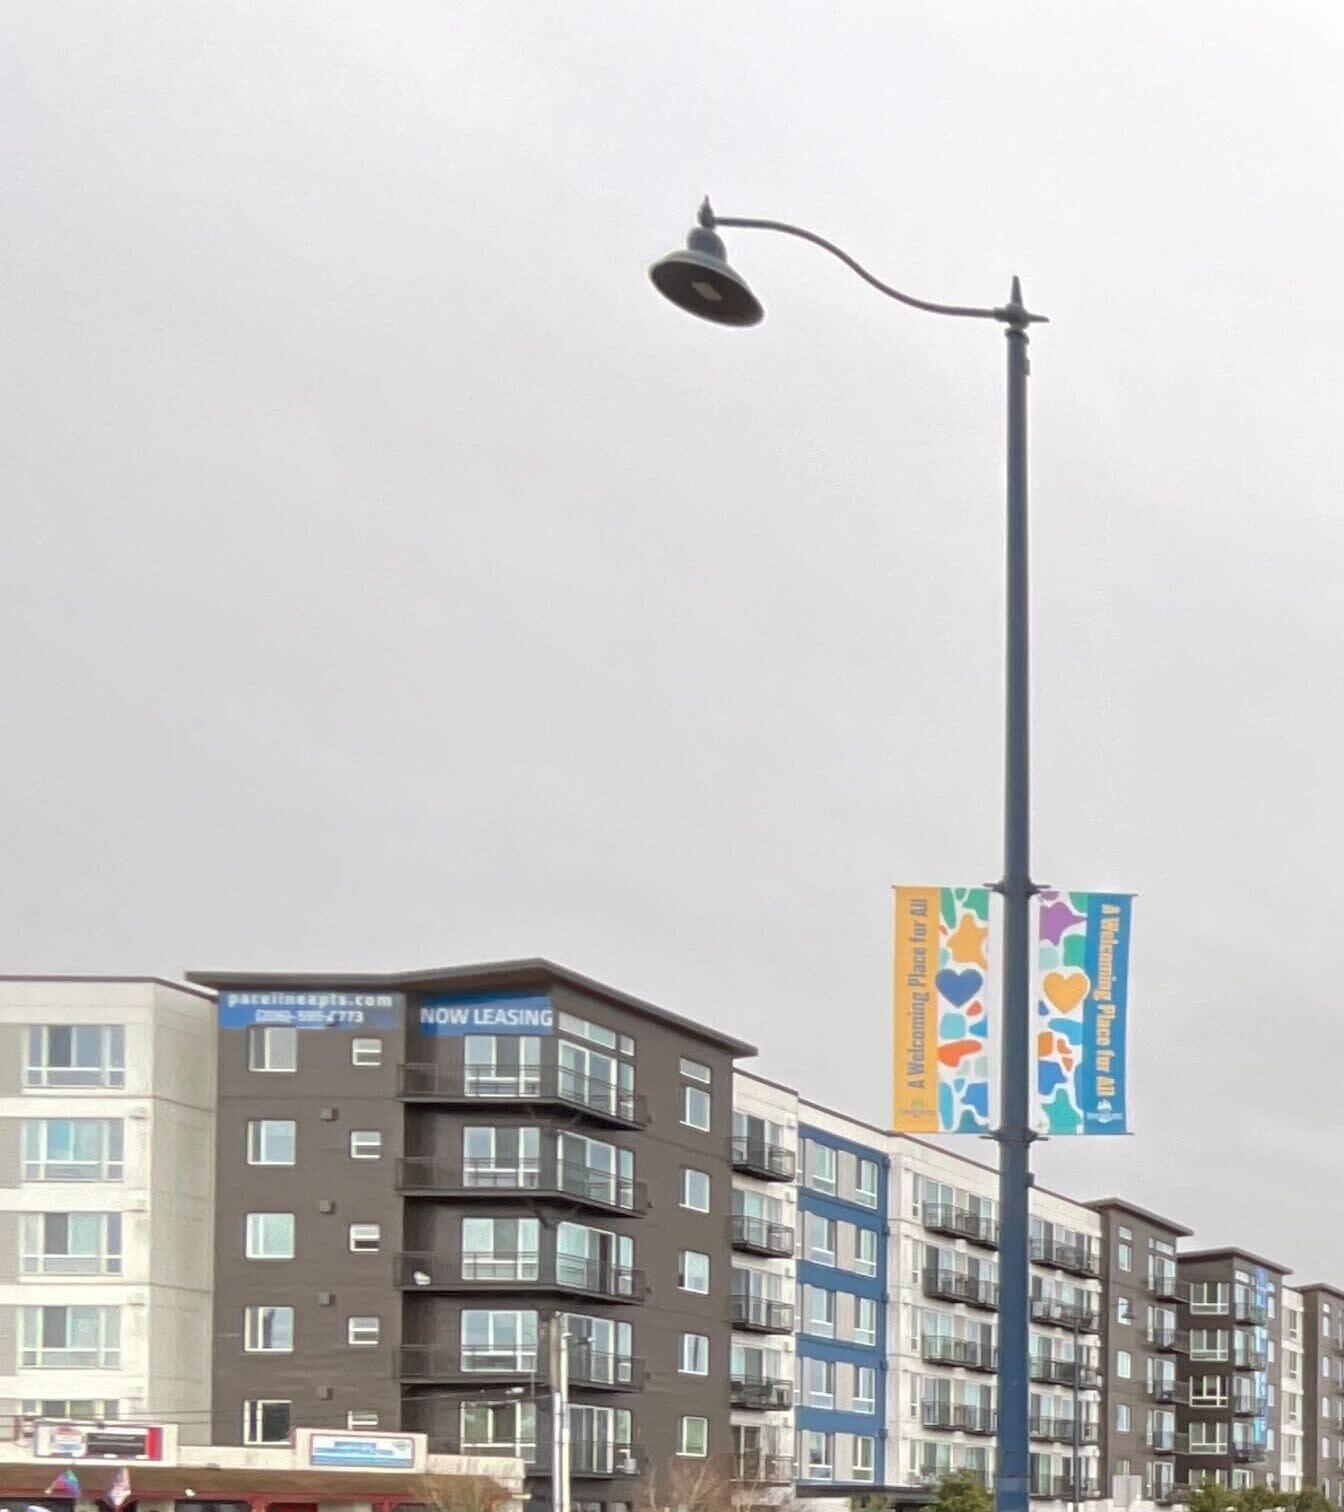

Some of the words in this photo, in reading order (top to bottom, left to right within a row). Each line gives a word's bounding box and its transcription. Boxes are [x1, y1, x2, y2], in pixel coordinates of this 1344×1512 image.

[908, 898, 928, 918] All
[1102, 904, 1120, 914] A
[908, 921, 928, 943] for
[908, 947, 927, 988] Place
[1093, 917, 1119, 1001] Welcoming
[420, 1007, 469, 1024] NOW
[474, 1008, 553, 1026] LEASING
[1096, 1004, 1116, 1047] Place
[907, 991, 930, 1076] Welcoming
[1096, 1049, 1115, 1073] for
[907, 1080, 925, 1089] A
[1096, 1076, 1116, 1096] All
